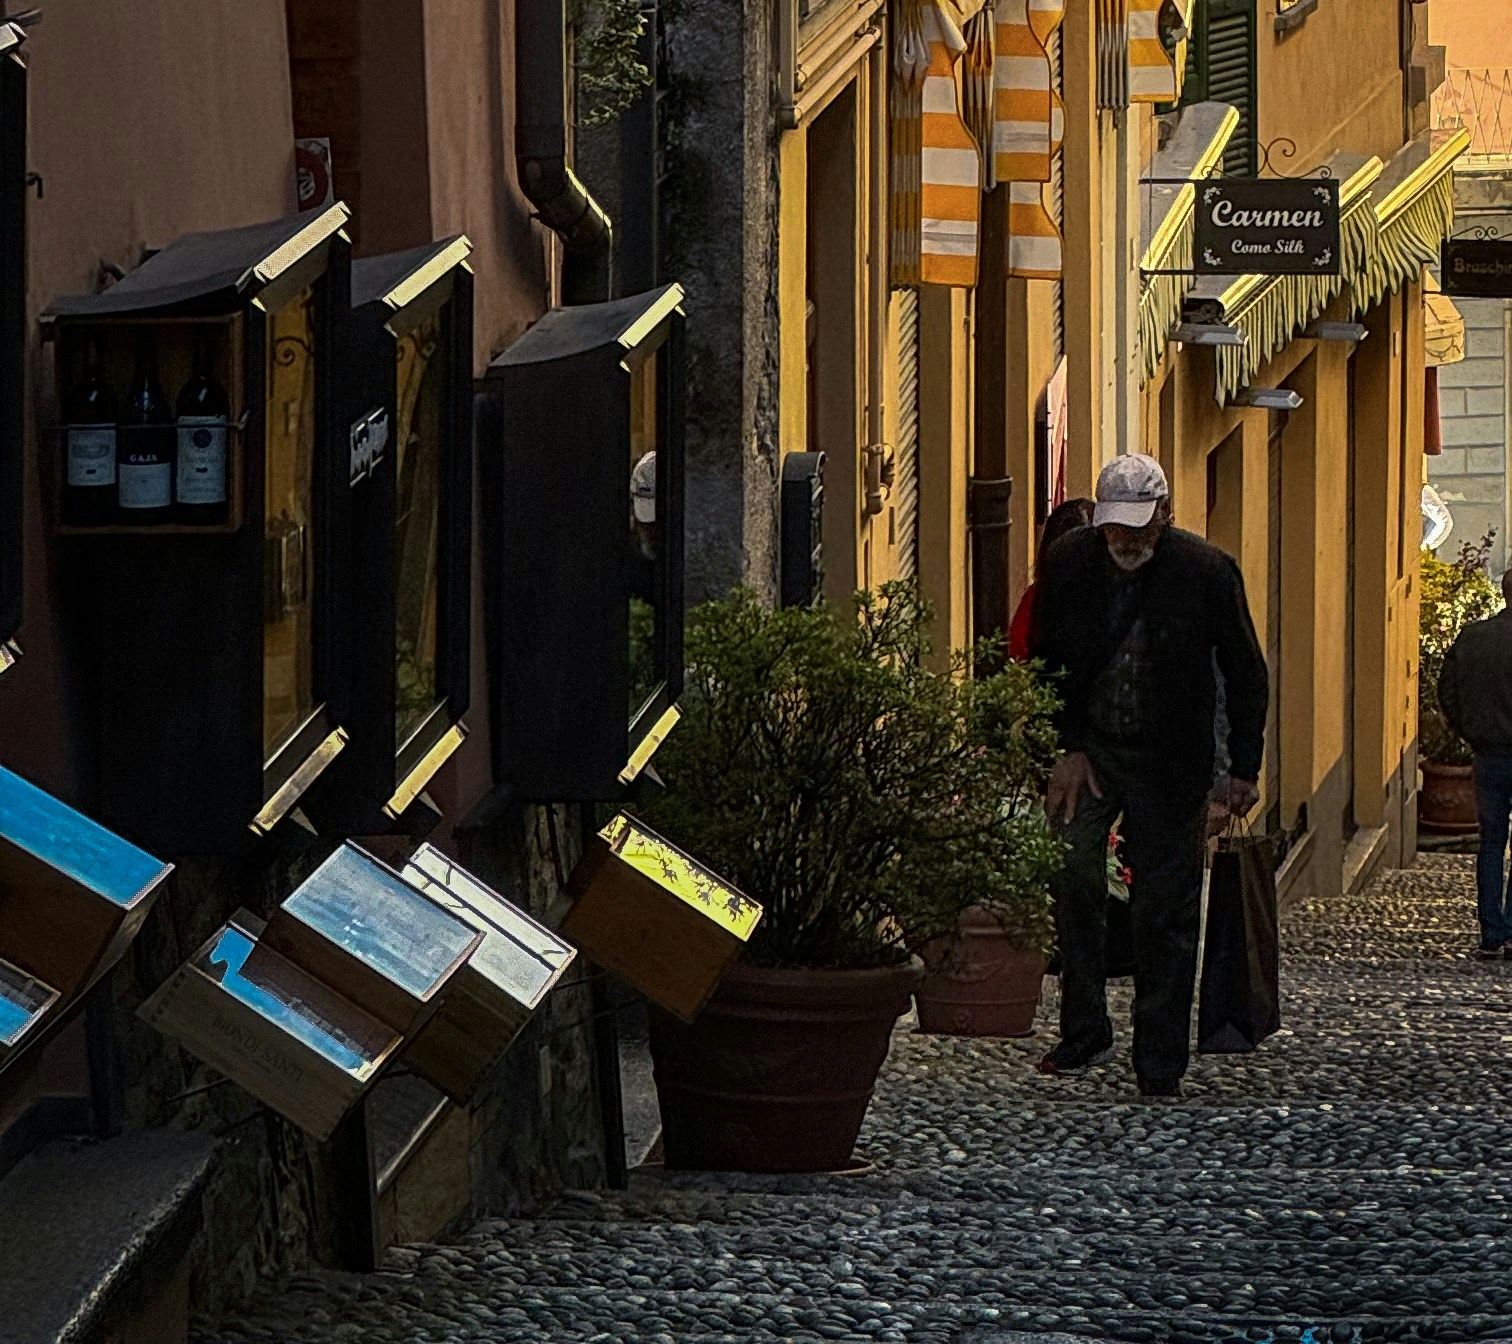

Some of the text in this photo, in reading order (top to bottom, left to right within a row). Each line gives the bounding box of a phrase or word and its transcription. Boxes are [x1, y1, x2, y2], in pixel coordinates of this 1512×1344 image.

[1211, 200, 1324, 227] Carmen
[1231, 239, 1305, 254] Como Silk
[129, 454, 158, 463] GAJA
